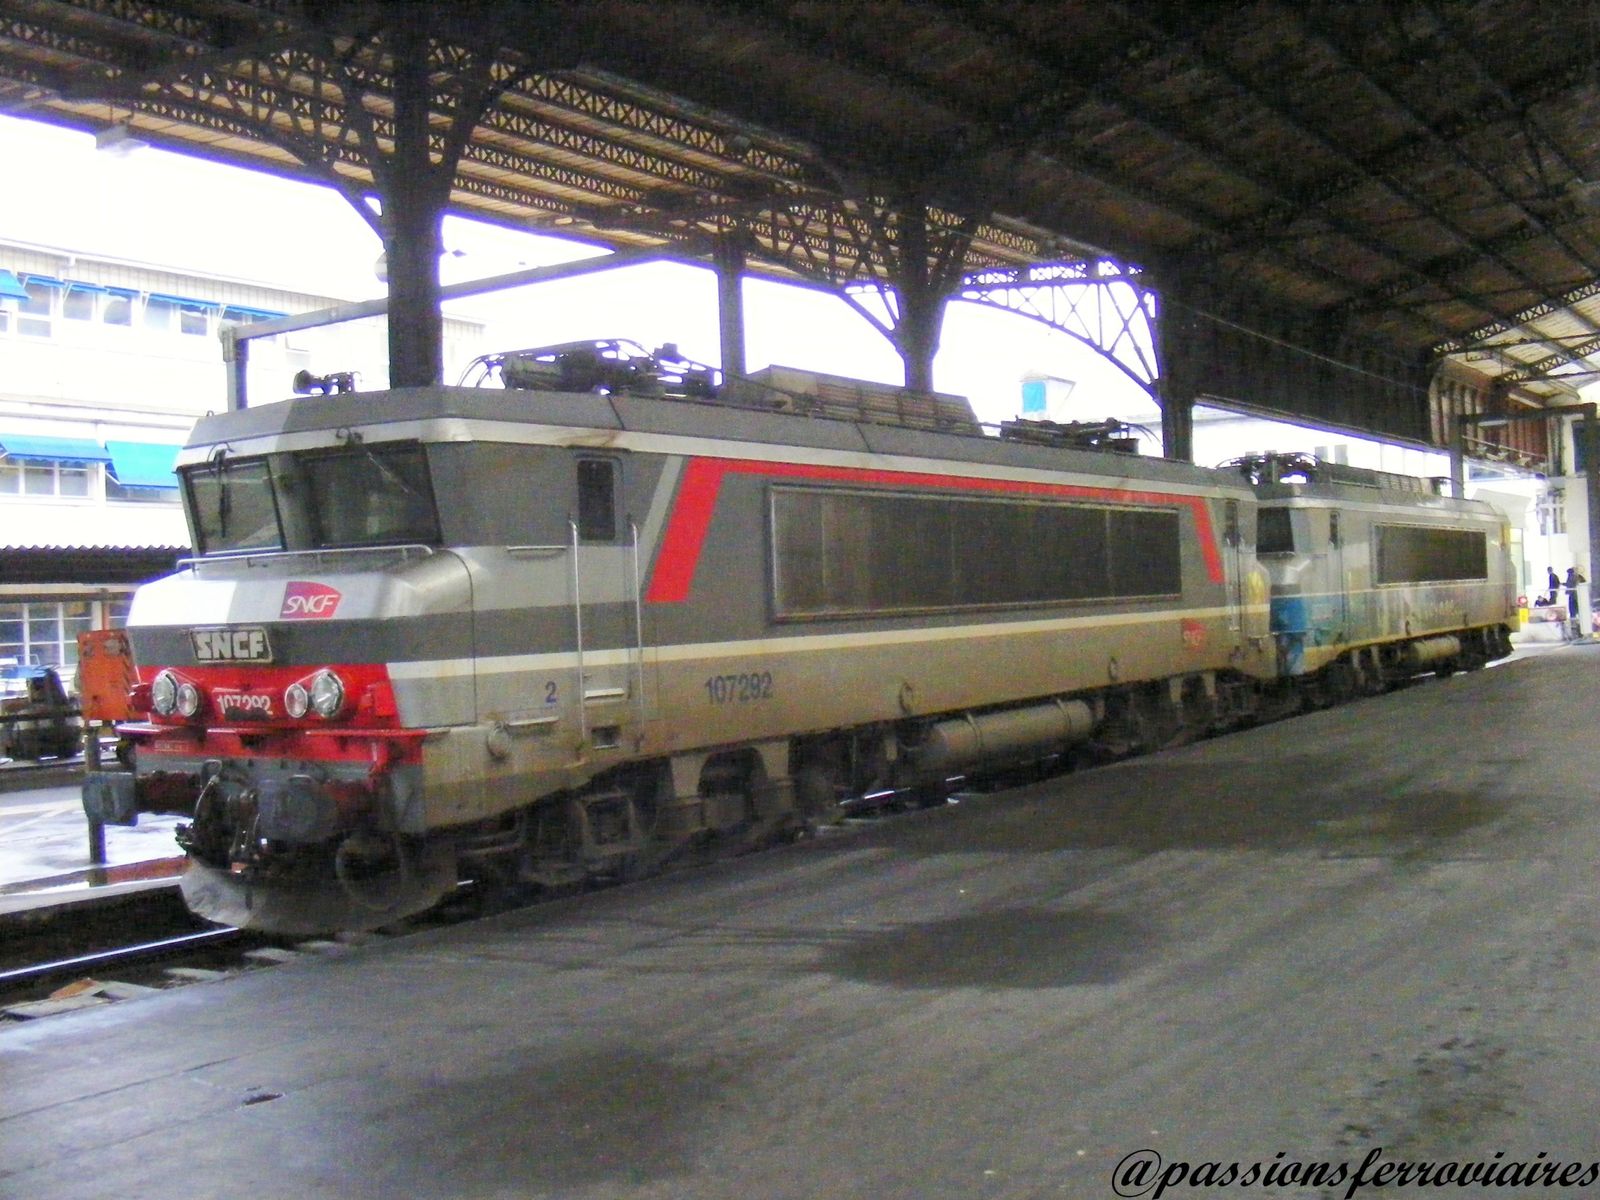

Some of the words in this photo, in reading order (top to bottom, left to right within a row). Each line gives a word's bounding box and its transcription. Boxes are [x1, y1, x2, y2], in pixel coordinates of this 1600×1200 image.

[283, 595, 339, 613] SNCF
[196, 631, 265, 660] SNCF
[545, 681, 556, 703] 2
